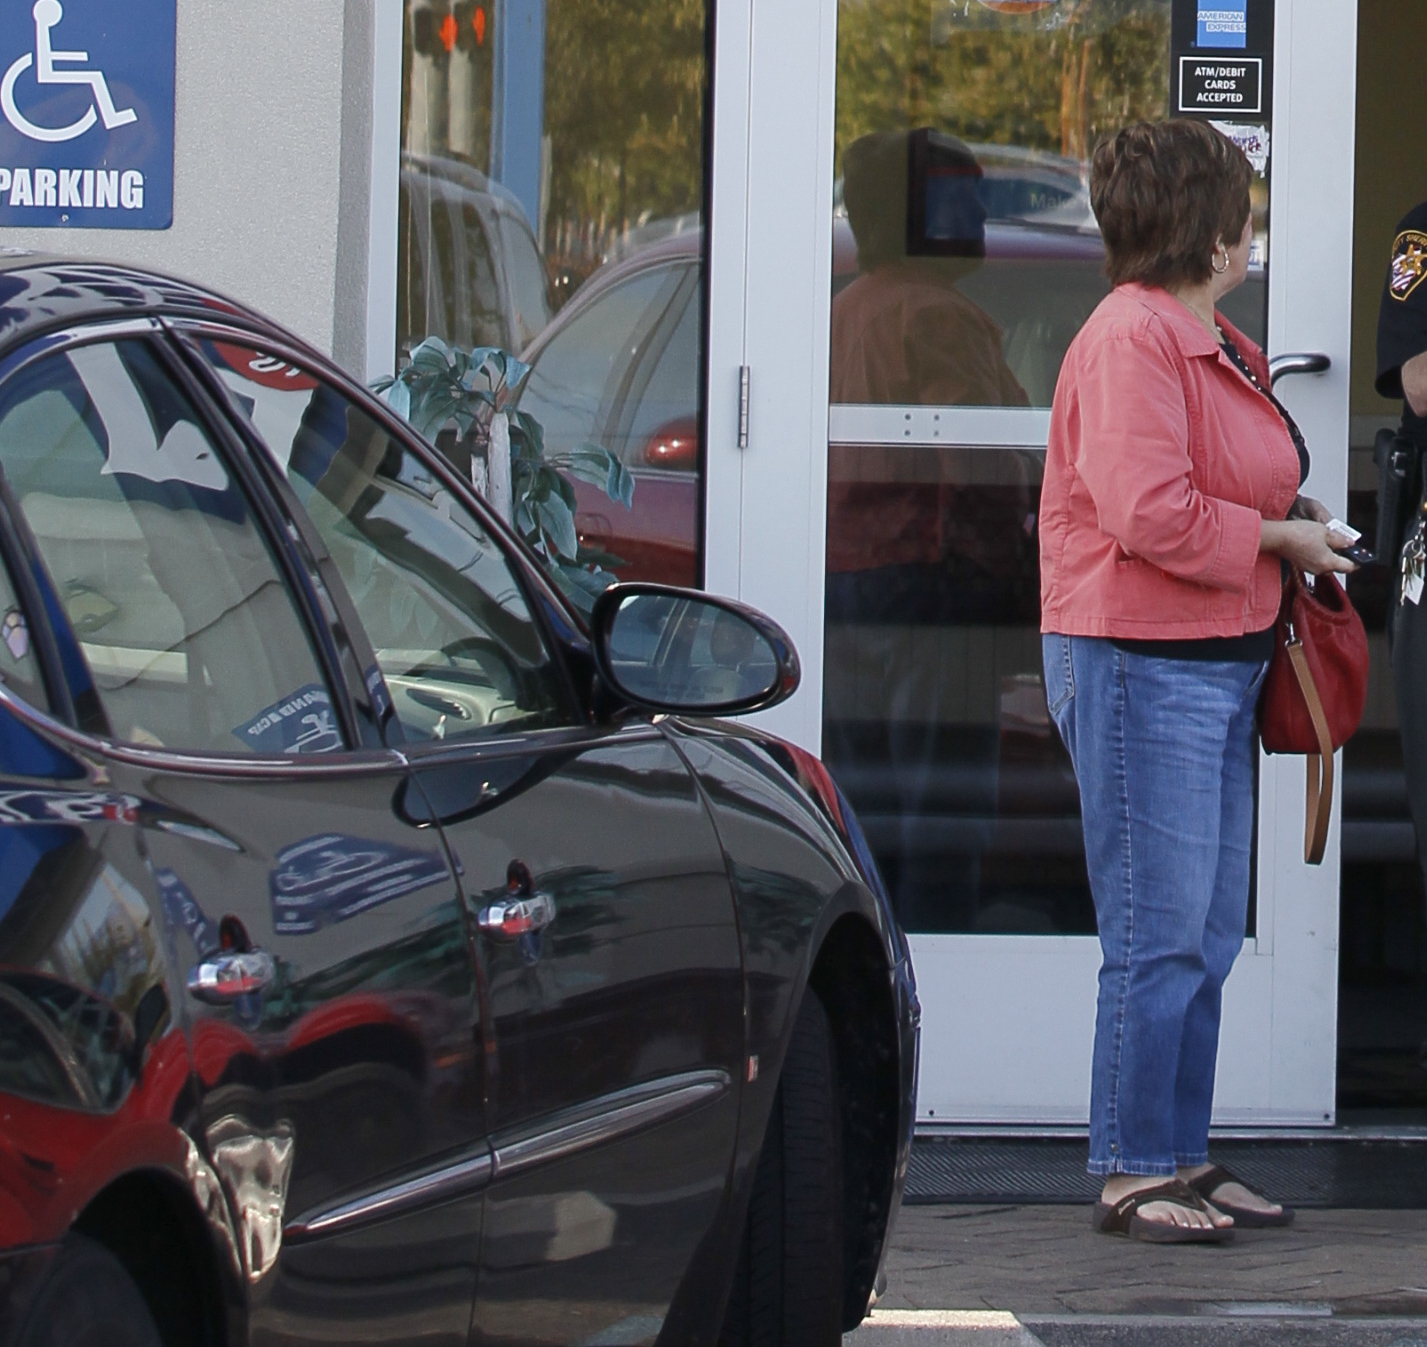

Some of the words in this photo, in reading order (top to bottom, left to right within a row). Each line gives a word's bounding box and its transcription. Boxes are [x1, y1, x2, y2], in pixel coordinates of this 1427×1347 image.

[1198, 10, 1244, 22] AMERICAN
[1195, 66, 1247, 78] ATM/DEBIT
[1204, 79, 1236, 90] CARDS
[1196, 92, 1243, 103] ACCEPTED
